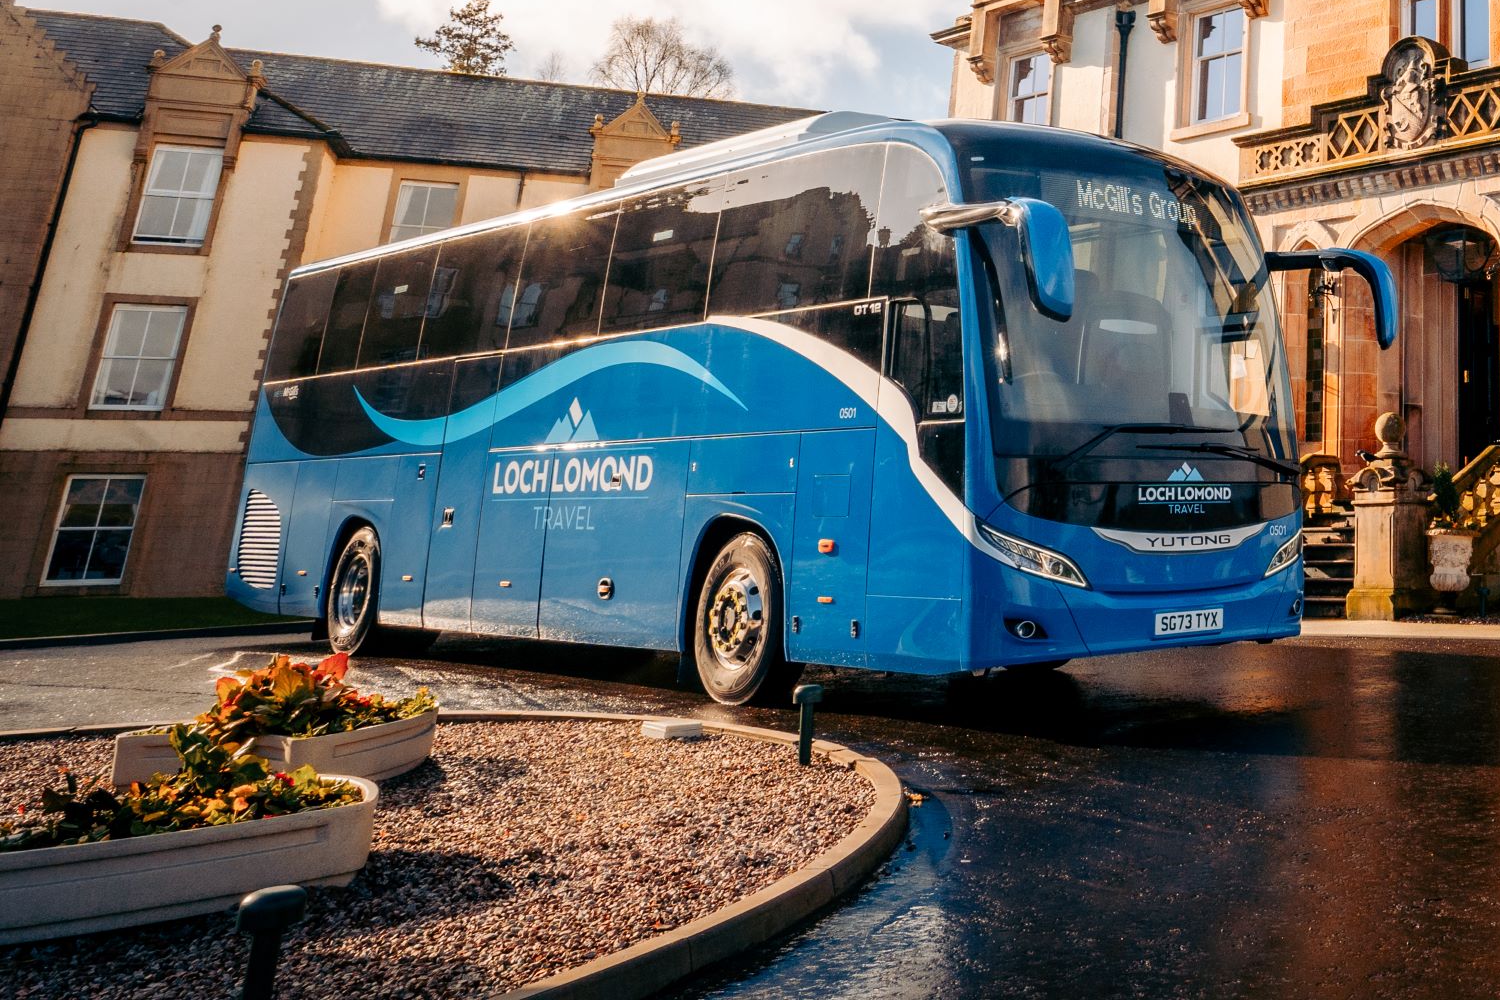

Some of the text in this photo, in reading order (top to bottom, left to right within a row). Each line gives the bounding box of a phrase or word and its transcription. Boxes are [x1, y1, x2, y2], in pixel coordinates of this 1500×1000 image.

[1076, 179, 1197, 230] McGill's Group
[839, 407, 857, 419] 0501
[492, 455, 654, 495] LOCH LOMOND
[1138, 487, 1232, 501] LOCH LOMOND
[1168, 503, 1206, 514] TRAVEL
[533, 505, 595, 531] TRAVEL
[1269, 525, 1287, 536] 0501
[1146, 534, 1231, 548] YUTONG
[1161, 612, 1218, 631] SG73 TYX
